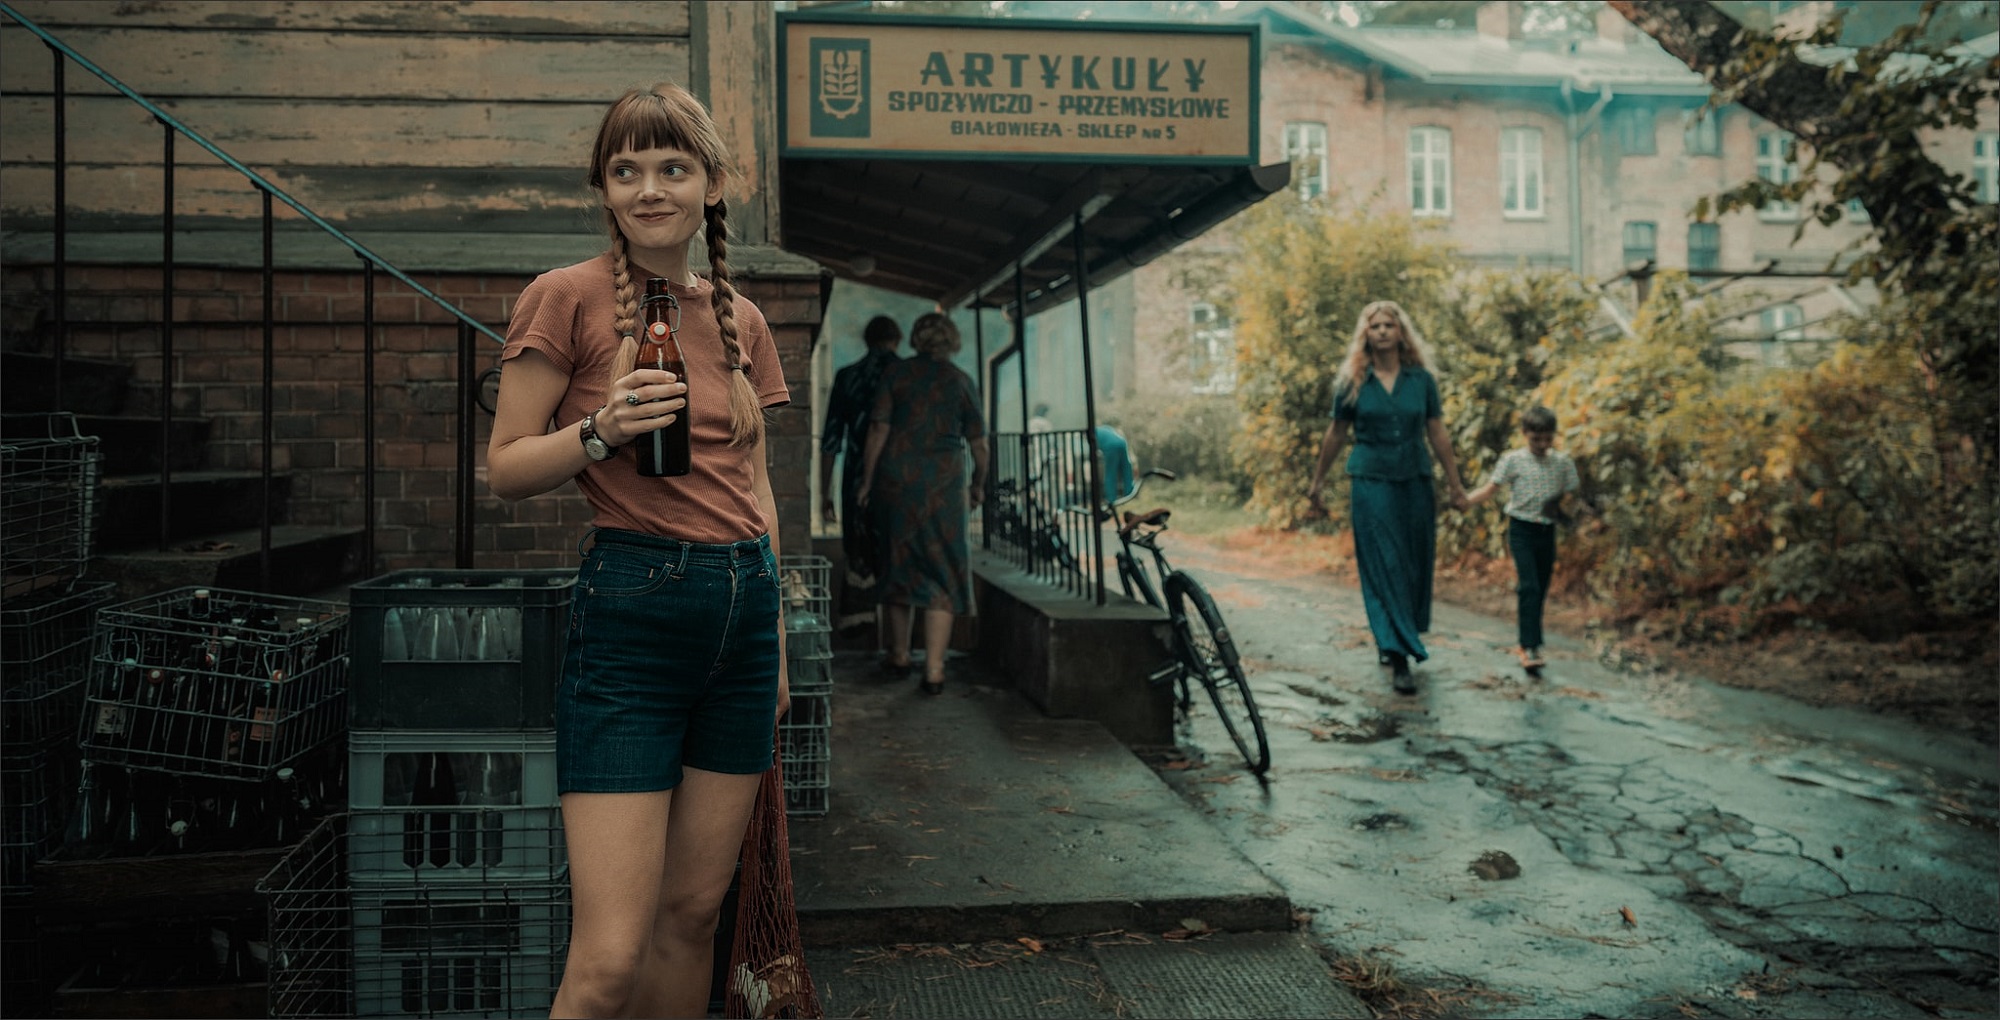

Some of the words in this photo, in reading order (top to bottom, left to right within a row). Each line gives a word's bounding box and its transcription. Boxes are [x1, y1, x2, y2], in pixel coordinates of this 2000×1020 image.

[920, 51, 1207, 94] ARTYKUŁY
[1057, 94, 1230, 120] PRZEMYSŁOWE
[1077, 123, 1137, 139] SKLEP
[1165, 124, 1177, 141] 5
